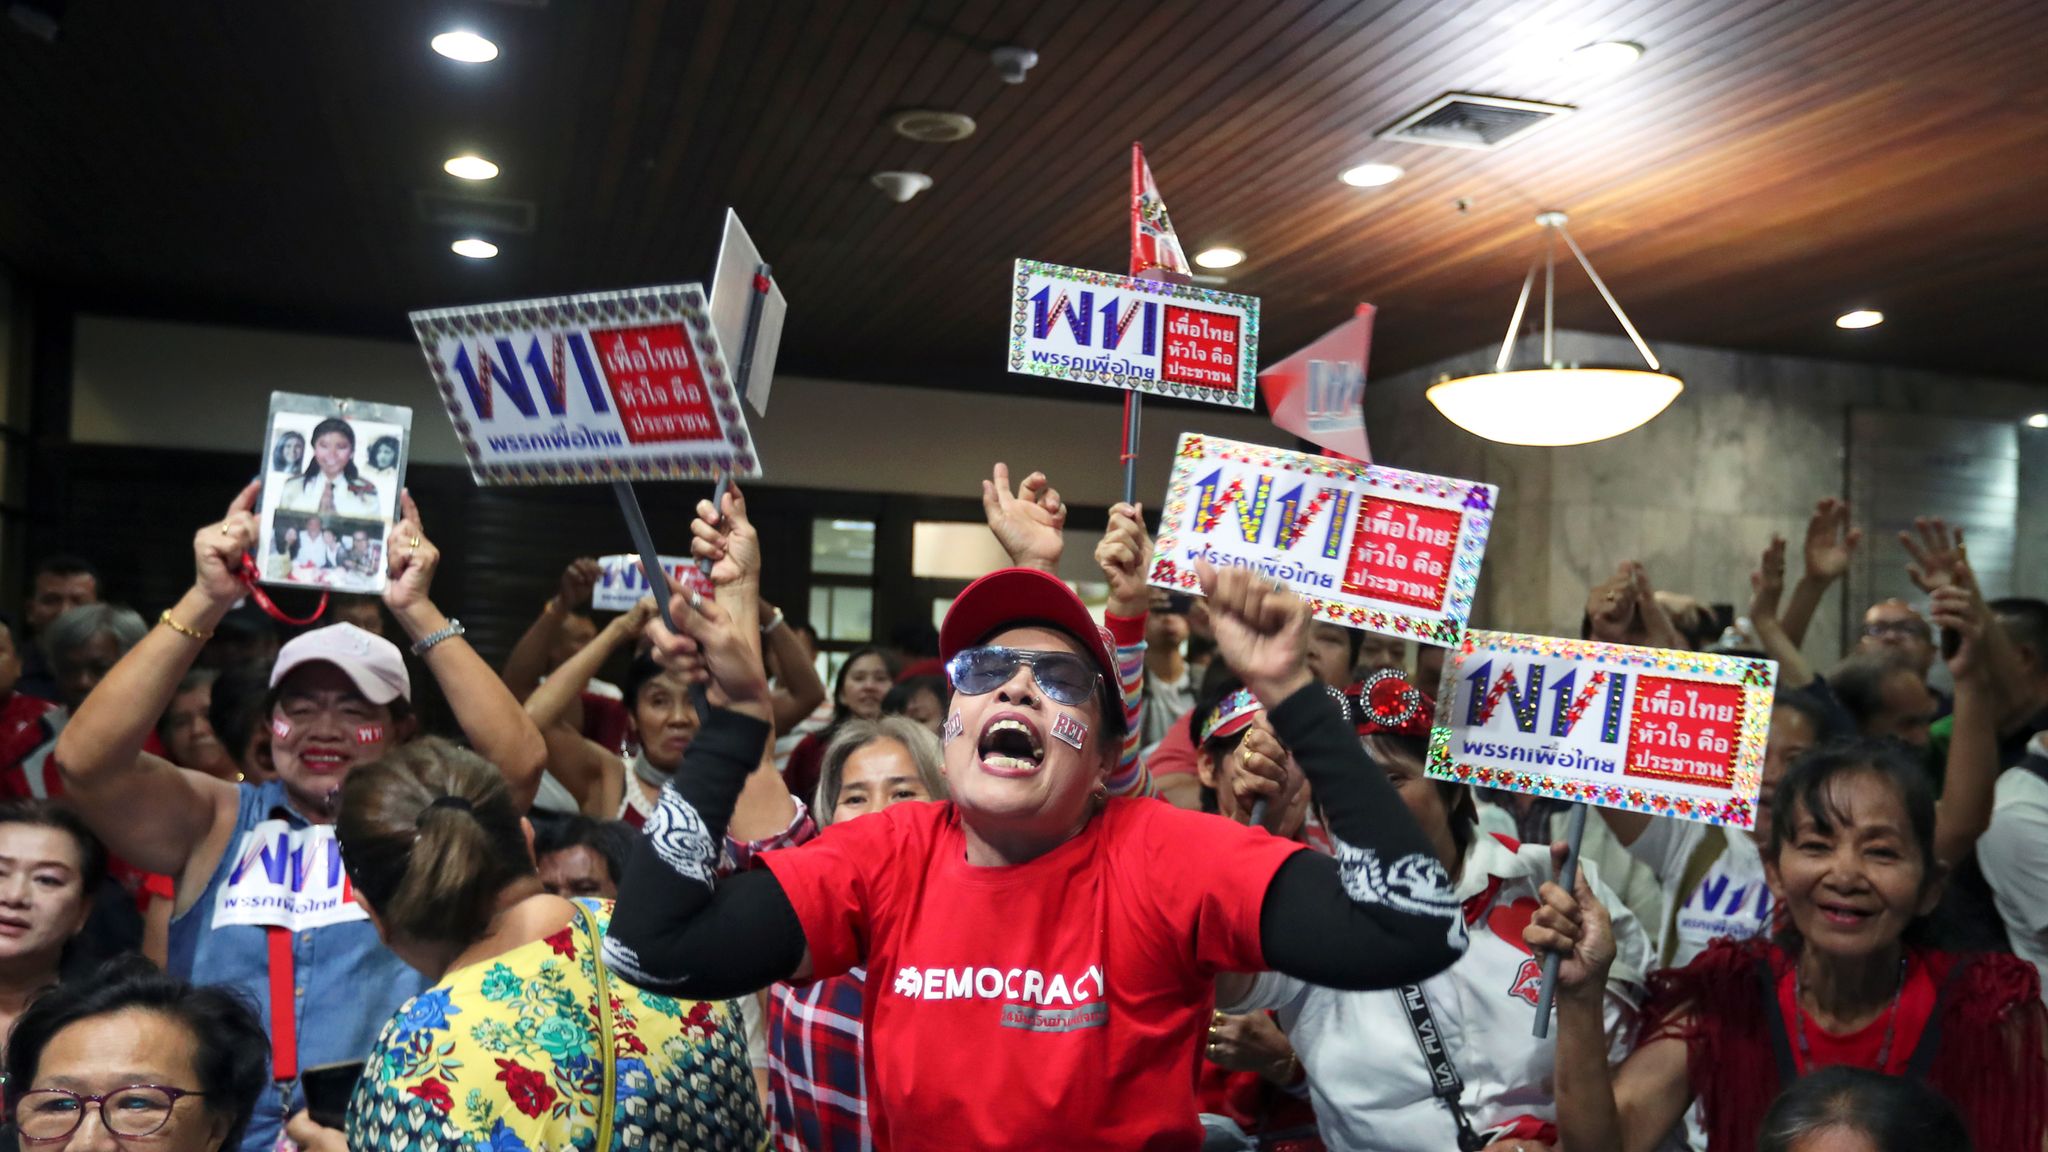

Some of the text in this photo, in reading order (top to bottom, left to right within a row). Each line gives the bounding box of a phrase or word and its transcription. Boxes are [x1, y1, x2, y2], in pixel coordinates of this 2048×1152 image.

[1029, 284, 1158, 356] พท
[1169, 313, 1234, 344] เพื่อไทย
[606, 333, 689, 374] เพื่อไทย
[1032, 350, 1155, 380] พรรคเพื่อไทย
[1168, 340, 1234, 366] หัวใจ คือ
[454, 332, 610, 421] พท
[1168, 361, 1232, 384] ประชาชน
[619, 375, 701, 408] หัวใจ คือ
[487, 421, 624, 452] พรรคเพื่อไทย
[630, 411, 711, 435] ประชาชน
[1191, 466, 1353, 560] พท
[1362, 504, 1451, 547] เพื่อไทย
[1357, 541, 1443, 576] หัวใจ คือ
[1351, 568, 1437, 600] ประชาชน
[1465, 659, 1628, 744] พท
[1641, 683, 1734, 722] เพื่อไทย
[1637, 721, 1729, 753] หัวใจ คือ
[1463, 739, 1615, 773] พรรคเพื่อไทย
[1634, 749, 1725, 778] ประชาชน
[1418, 1018, 1441, 1055] FILA
